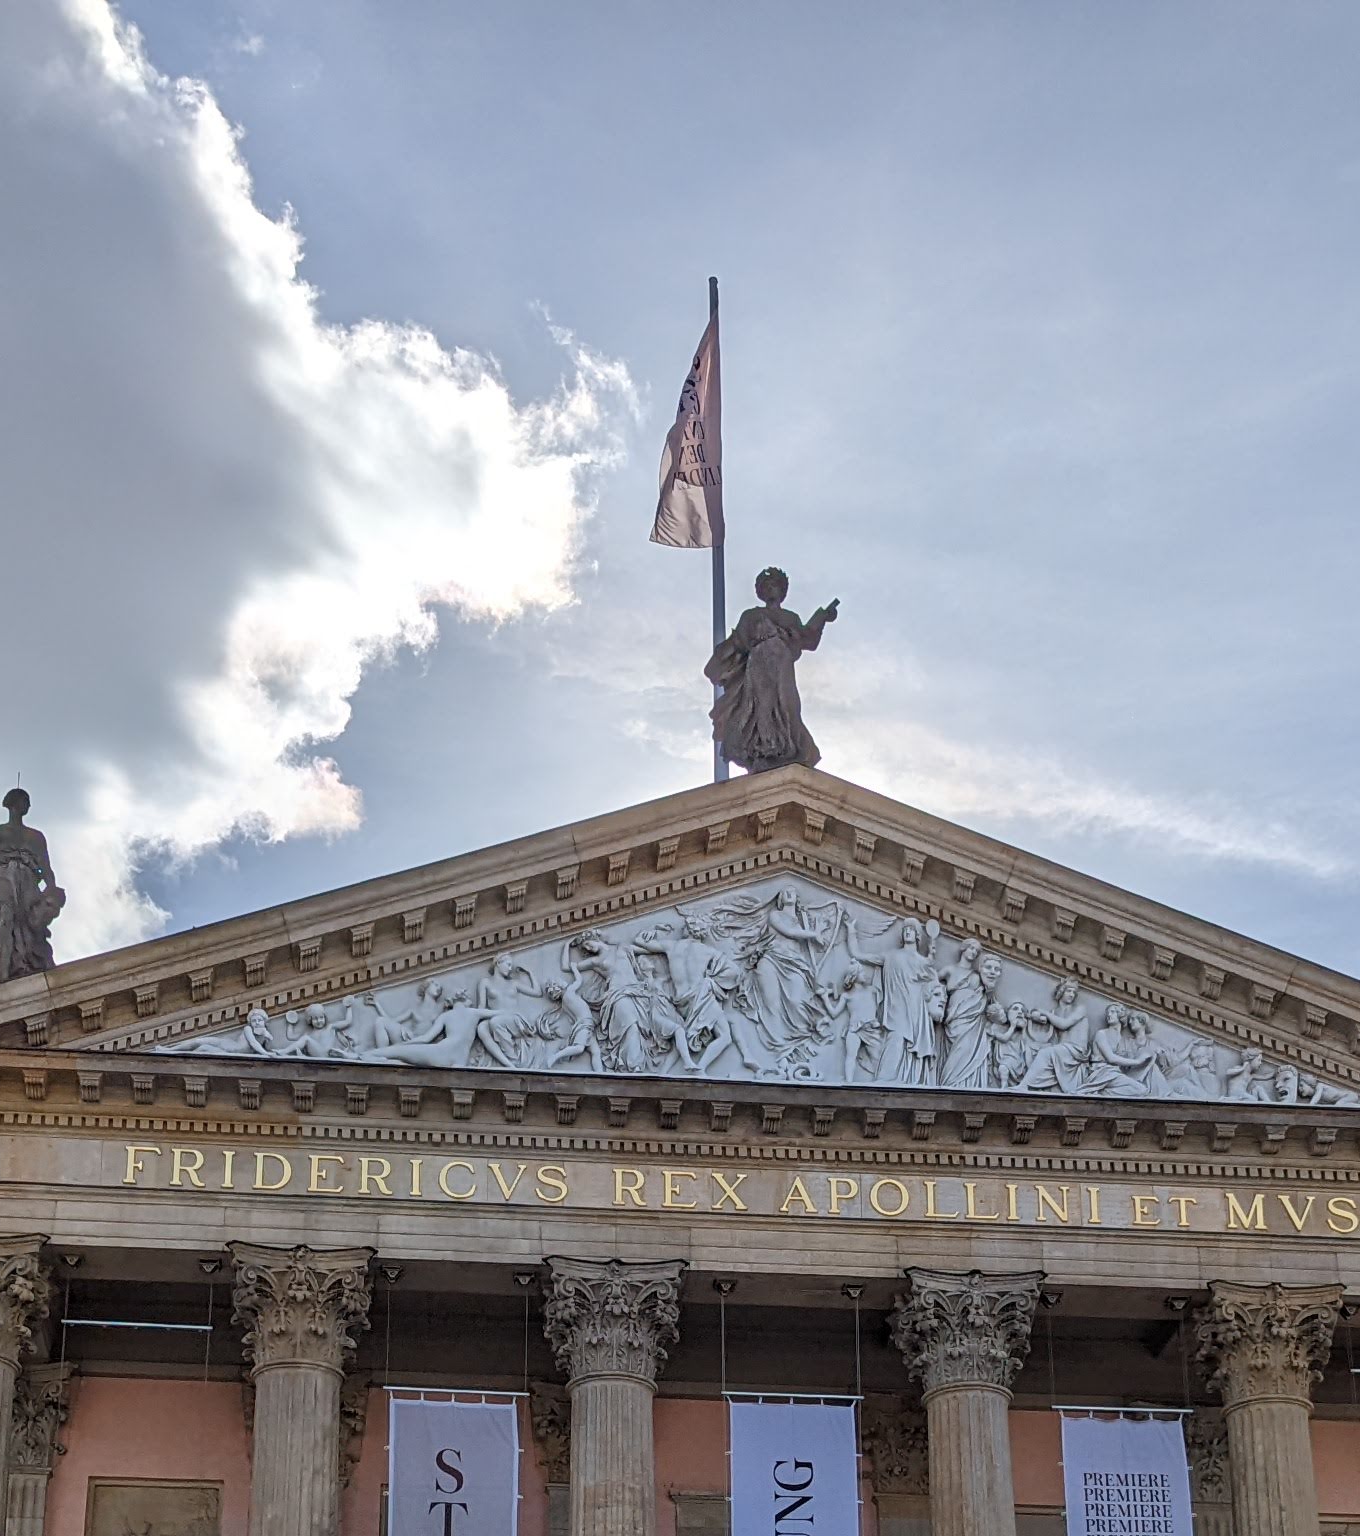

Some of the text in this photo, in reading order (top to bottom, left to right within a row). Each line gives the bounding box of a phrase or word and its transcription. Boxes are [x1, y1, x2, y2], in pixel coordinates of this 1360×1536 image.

[122, 1145, 570, 1202] FRIDERICVS
[612, 1168, 749, 1211] REX
[779, 1175, 1102, 1225] APOLLINI
[1130, 1195, 1198, 1227] ET
[1083, 1472, 1171, 1488] PREMIERE
[1084, 1487, 1172, 1503] PREMIERE
[1084, 1503, 1173, 1518] PREMIERE
[1085, 1518, 1174, 1533] PREMIERE
